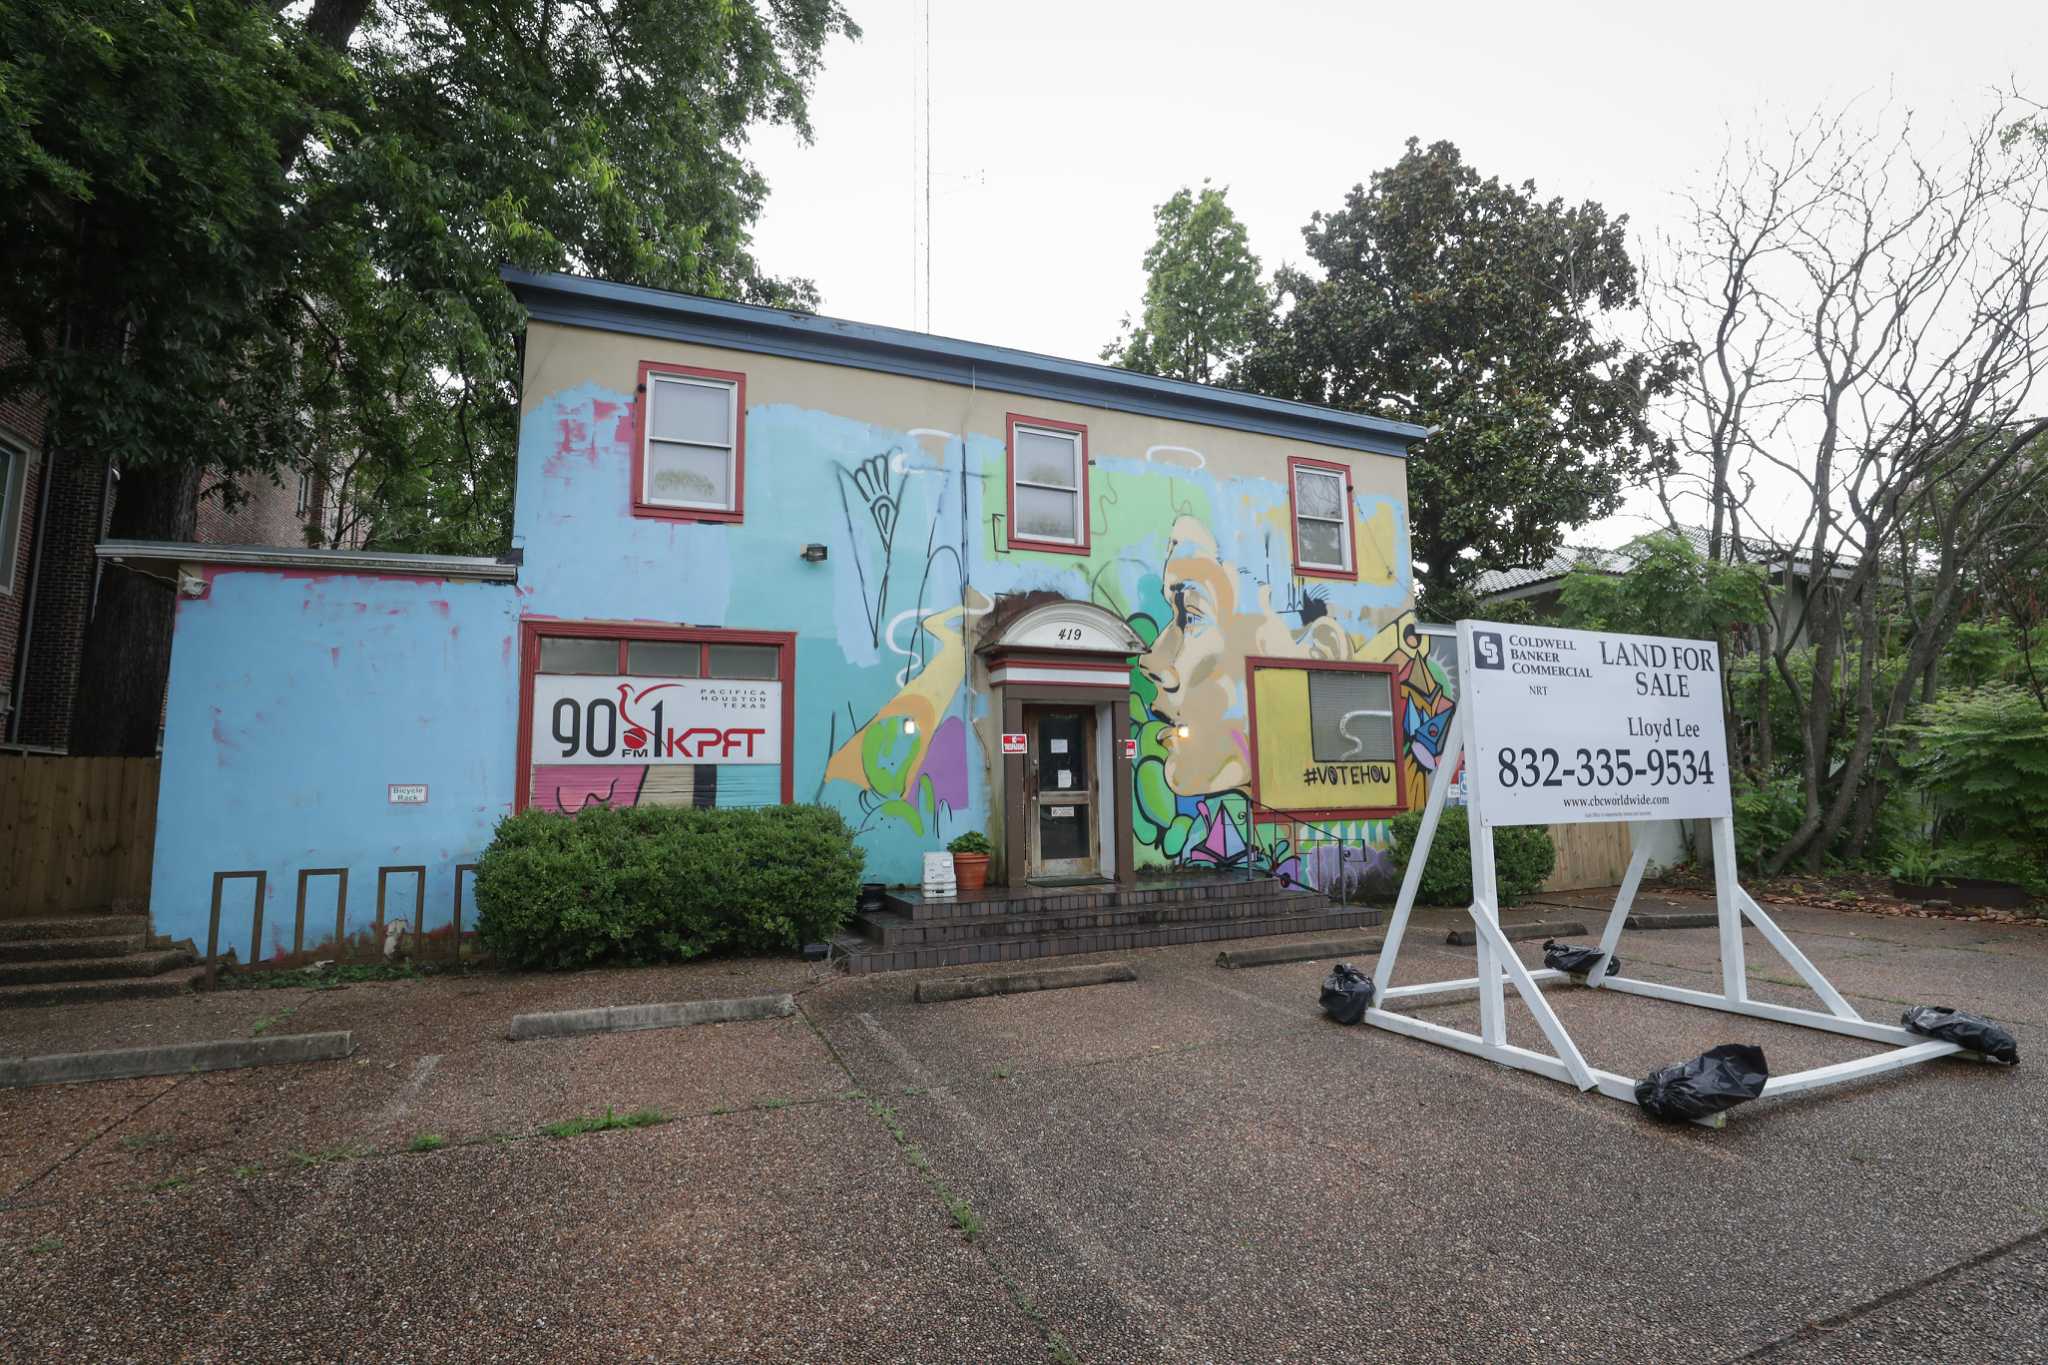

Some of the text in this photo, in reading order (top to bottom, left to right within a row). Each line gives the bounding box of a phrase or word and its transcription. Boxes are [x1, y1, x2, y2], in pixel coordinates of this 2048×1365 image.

[1058, 628, 1082, 640] 419
[1509, 635, 1576, 650] COLDWELL
[1511, 649, 1560, 662] BANKER
[1599, 641, 1714, 672] LAND FOR
[1512, 663, 1592, 678] COMMERCIAL
[1529, 685, 1548, 696] NRT
[1635, 671, 1690, 698] SALE
[1627, 717, 1700, 743] Lloyd Lee
[667, 728, 766, 758] KPFT
[622, 749, 648, 757] FM
[1498, 747, 1715, 788] 832-335-9534
[1303, 765, 1391, 786] #VOTEHOU
[1563, 794, 1670, 808] www.cbcworldwide.com
